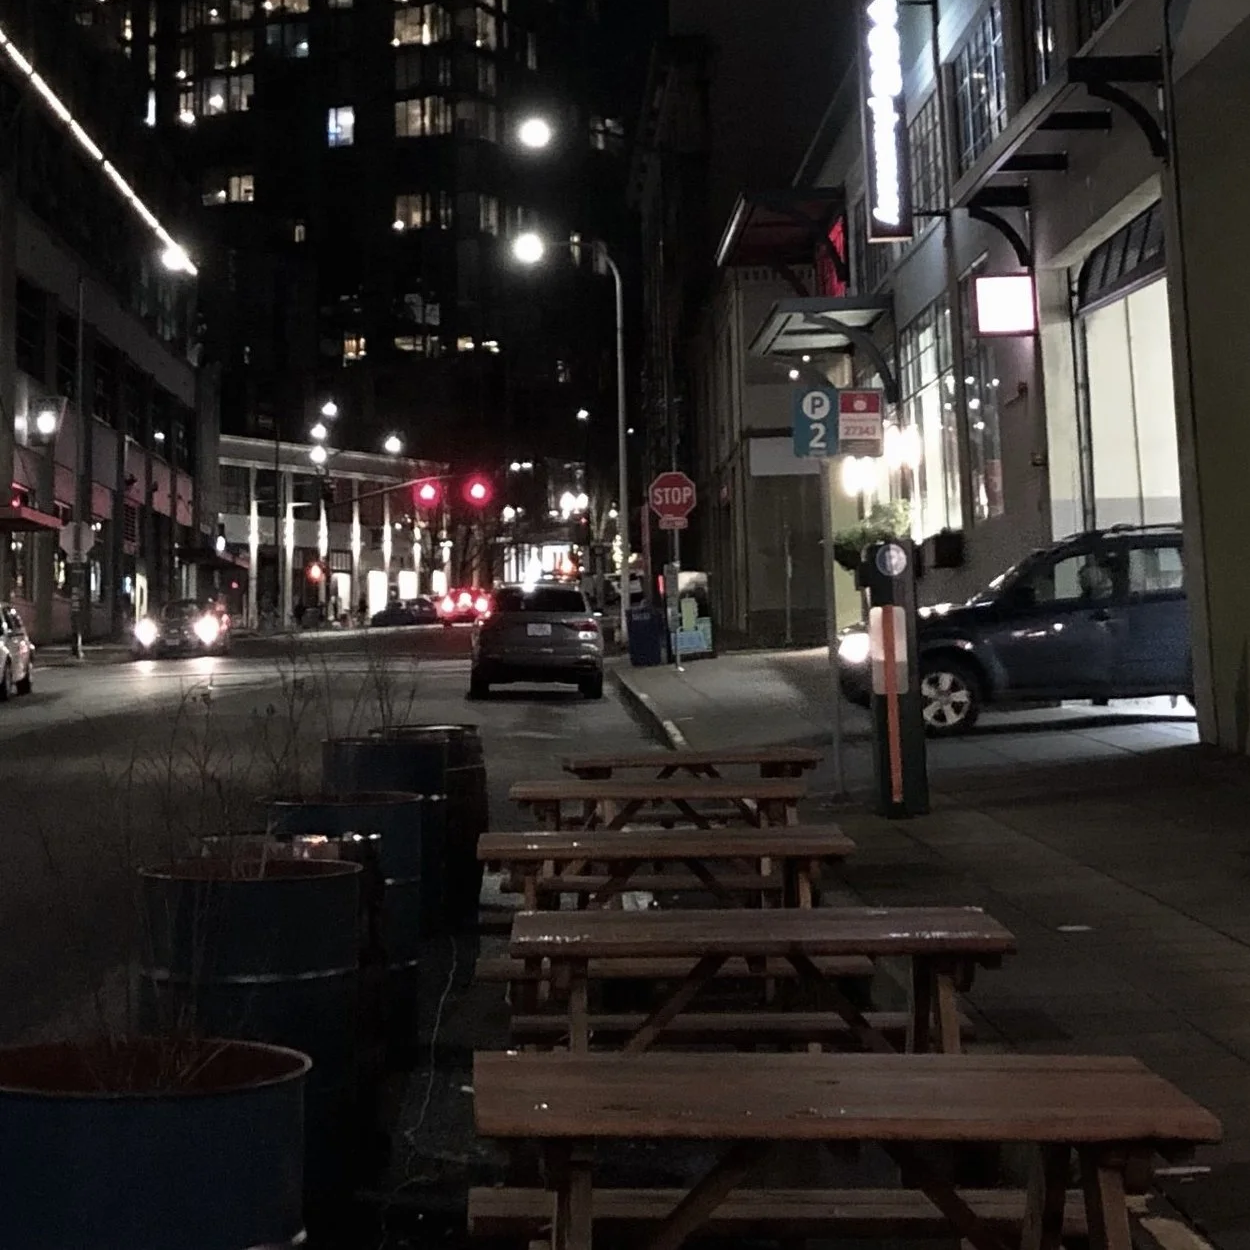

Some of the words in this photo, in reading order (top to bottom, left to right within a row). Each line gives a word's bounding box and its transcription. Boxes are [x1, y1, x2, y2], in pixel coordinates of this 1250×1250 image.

[810, 396, 824, 415] P
[809, 422, 827, 449] 2
[653, 486, 693, 505] STOP
